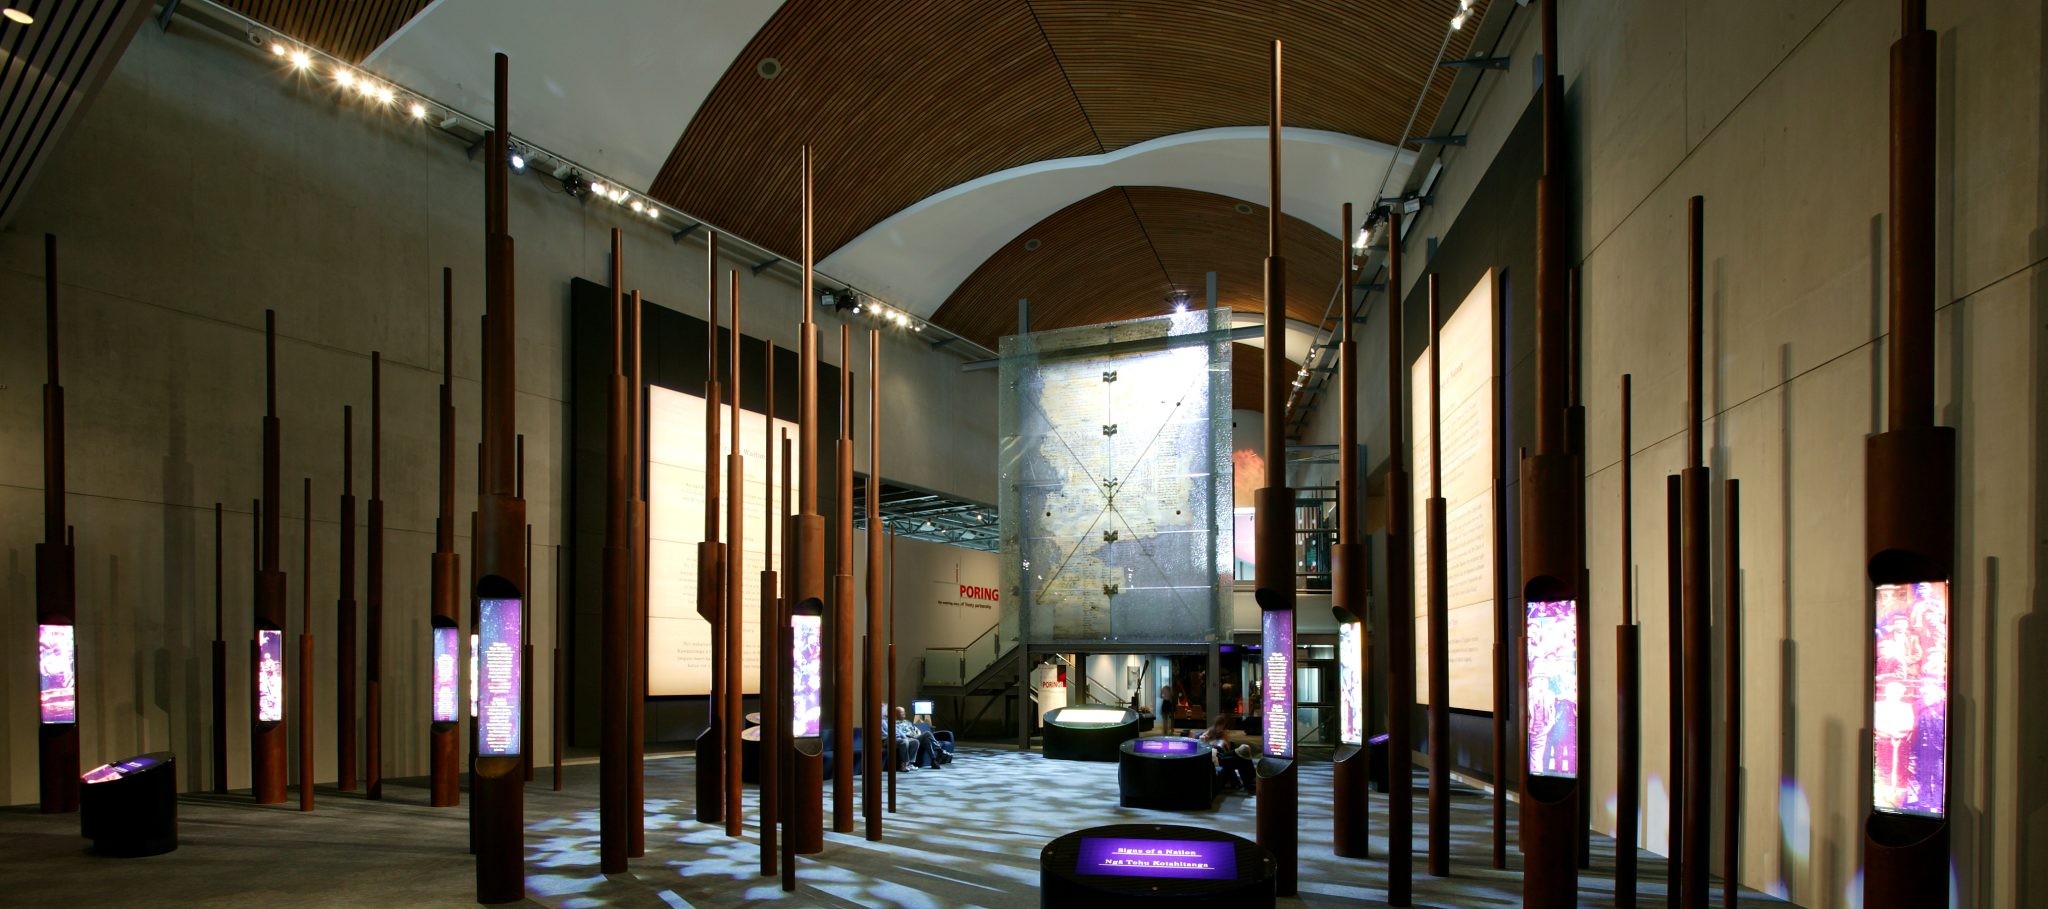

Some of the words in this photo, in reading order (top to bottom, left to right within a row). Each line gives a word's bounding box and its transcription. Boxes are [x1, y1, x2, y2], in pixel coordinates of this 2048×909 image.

[960, 584, 999, 602] PORING
[1118, 847, 1143, 855] Signs
[1152, 860, 1209, 868] Kotahitanga
